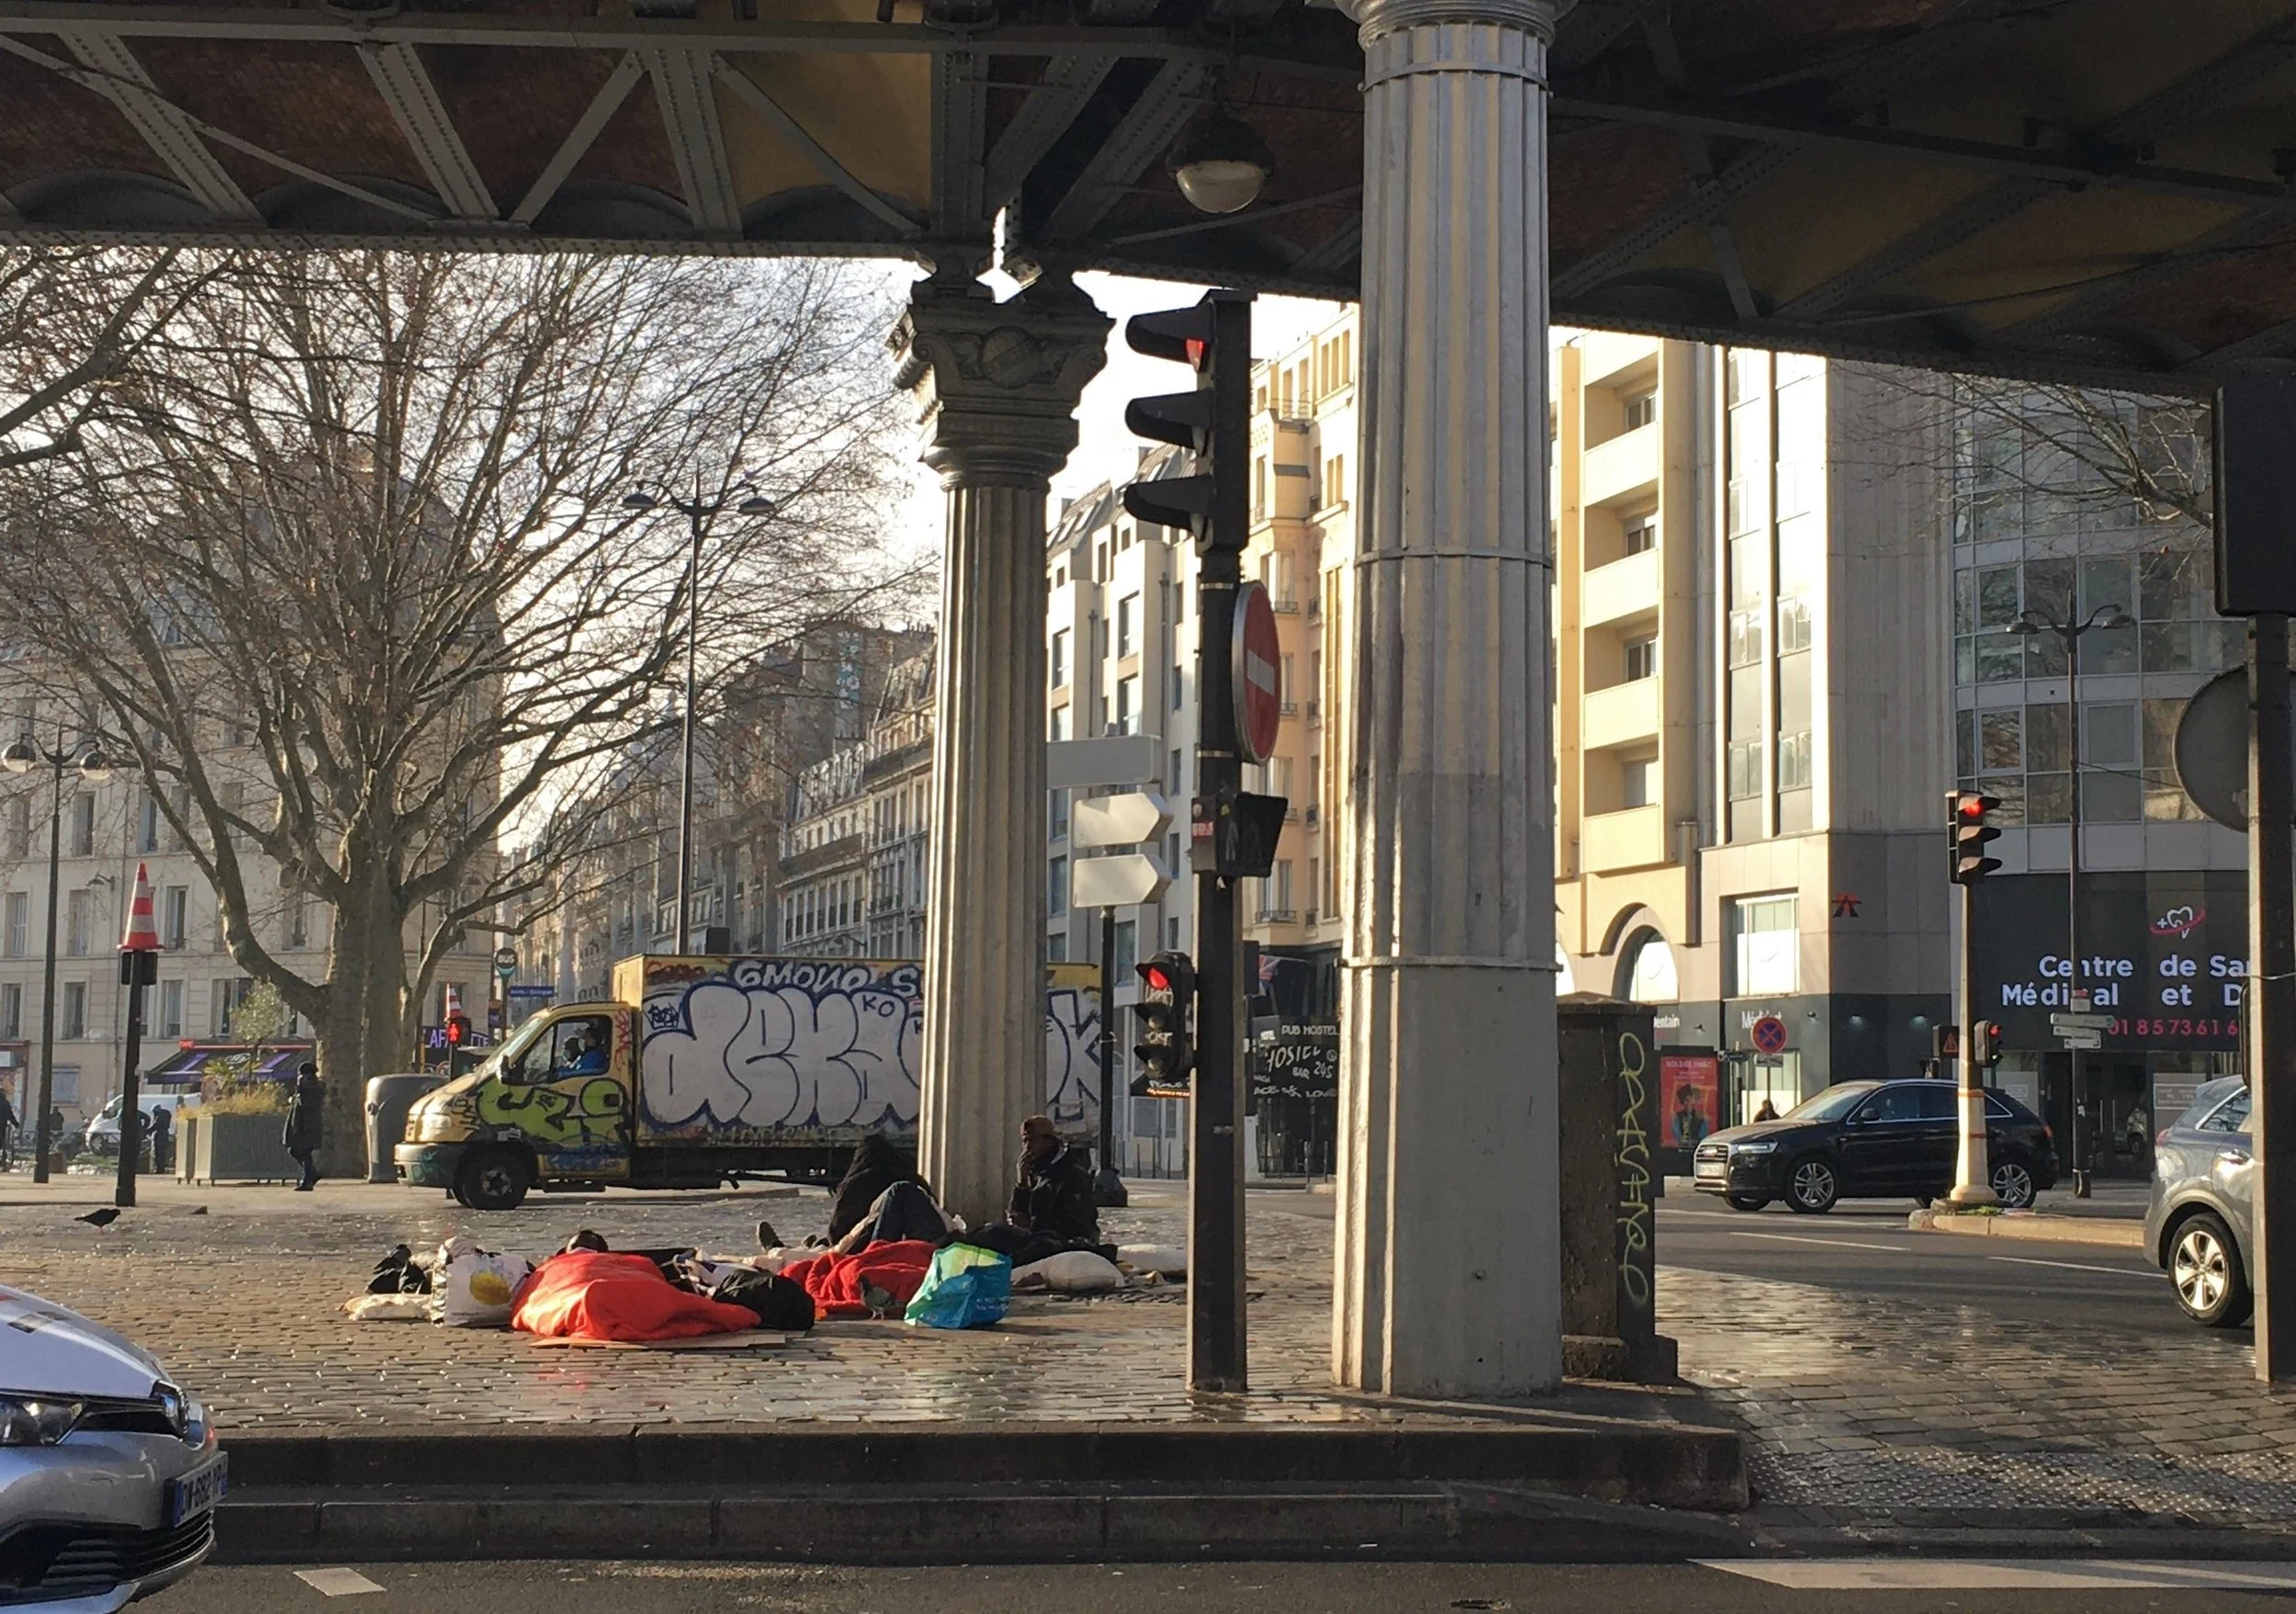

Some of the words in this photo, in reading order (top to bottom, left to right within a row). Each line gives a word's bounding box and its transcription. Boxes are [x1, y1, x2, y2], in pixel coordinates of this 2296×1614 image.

[497, 954, 515, 964] BUS
[2159, 954, 2197, 977] de
[2002, 982, 2119, 1007] Médial
[2161, 983, 2192, 1007] et
